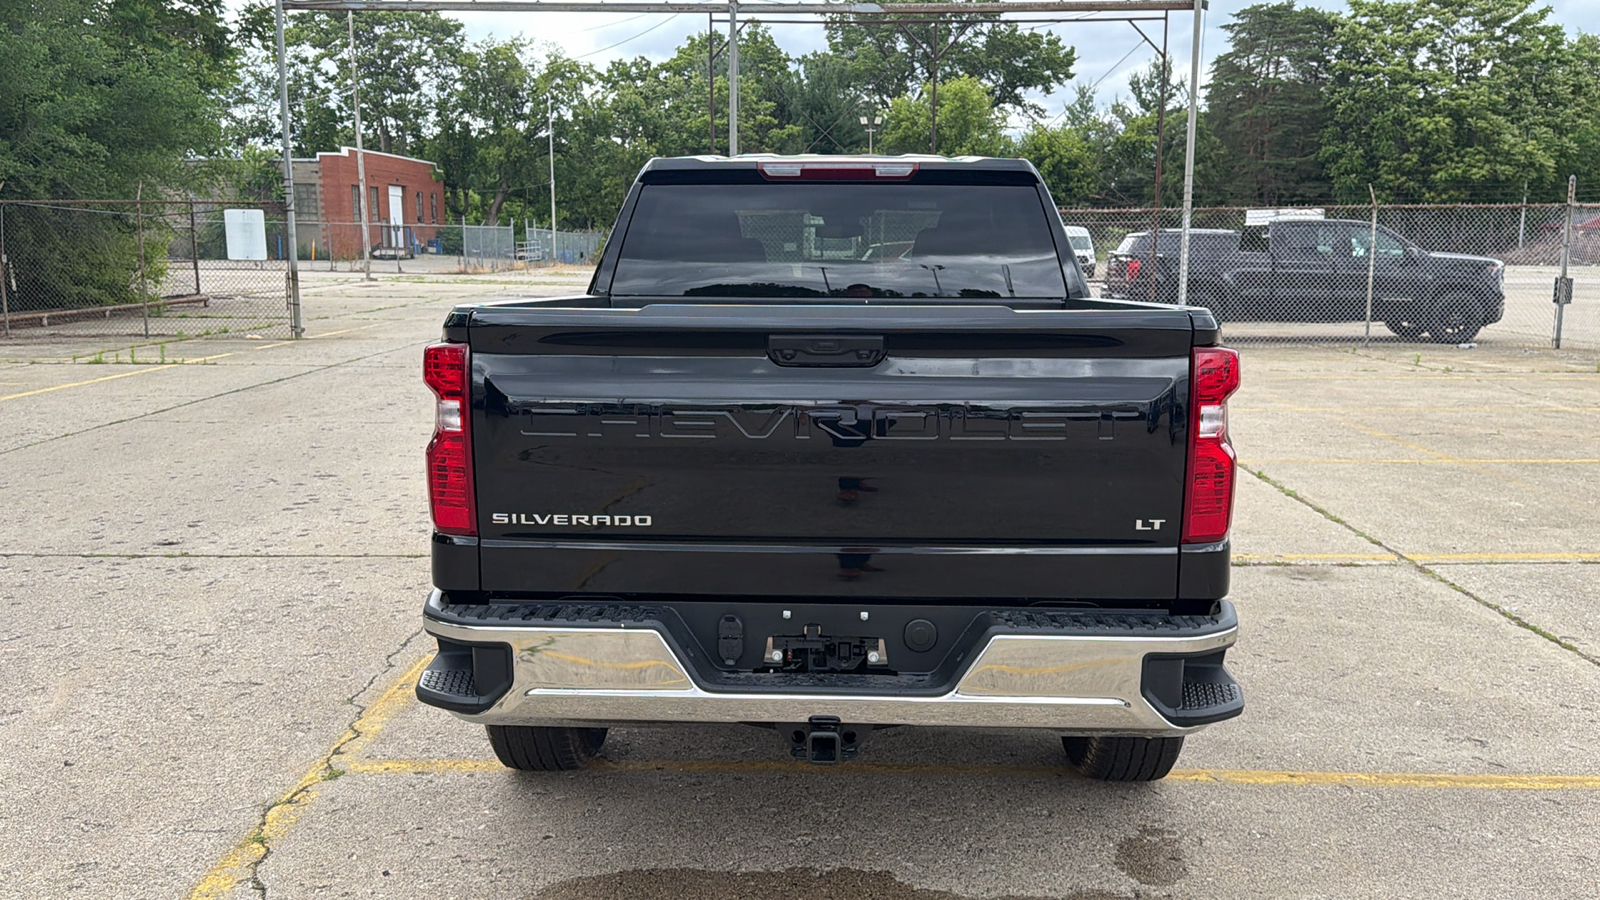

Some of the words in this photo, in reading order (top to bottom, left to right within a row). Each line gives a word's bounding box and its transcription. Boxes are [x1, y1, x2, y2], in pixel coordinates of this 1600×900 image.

[519, 405, 1139, 442] CHEVROLET
[491, 513, 652, 527] SILVERADO
[1135, 519, 1166, 531] LT
